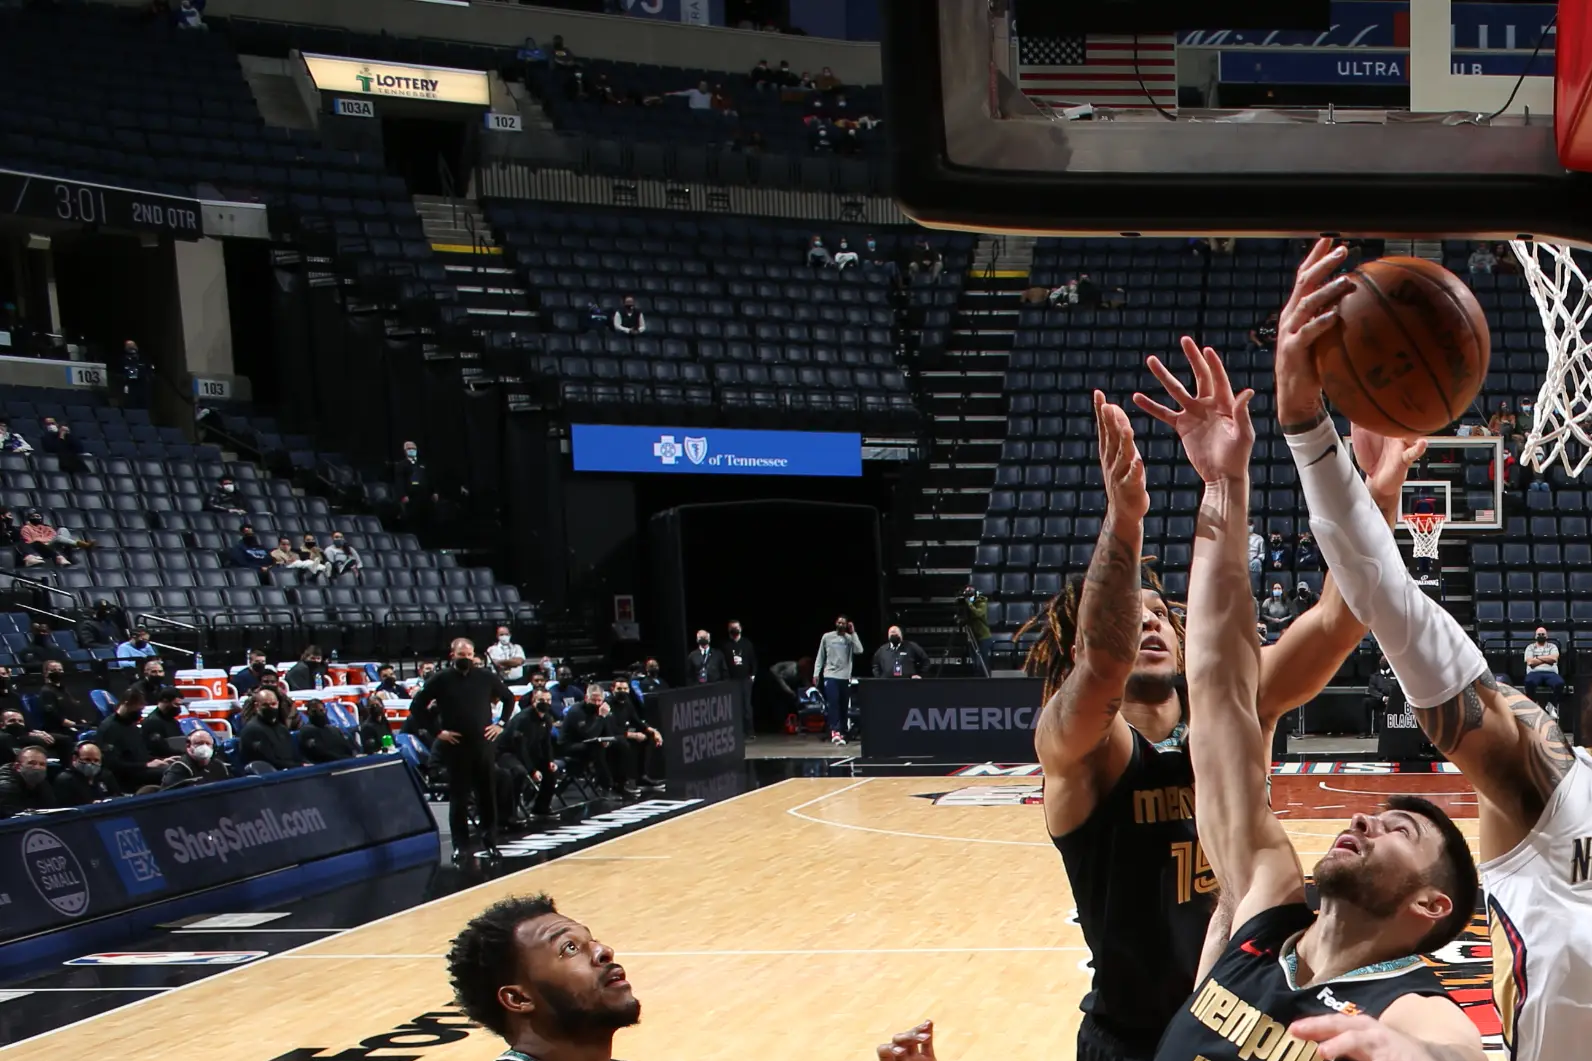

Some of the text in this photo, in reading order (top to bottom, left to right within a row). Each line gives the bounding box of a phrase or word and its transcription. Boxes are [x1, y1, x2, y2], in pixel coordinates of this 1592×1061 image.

[1337, 61, 1401, 76] ULTRA
[376, 74, 439, 92] LOTTERY
[378, 87, 437, 99] TENNESSEE
[341, 101, 371, 116] 103A
[495, 116, 516, 129] 102
[54, 184, 197, 230] 3:01 2ND QTR
[77, 369, 100, 383] 103
[203, 382, 224, 396] 103
[708, 454, 788, 467] of Tennessee
[213, 681, 222, 696] G
[671, 694, 733, 733] AMERICAN
[902, 706, 1043, 731] AMERIC
[1387, 714, 1418, 729] BLACK
[681, 726, 736, 764] EXPRESS
[164, 806, 328, 864] ShopSmall.com
[36, 855, 68, 875] SHOP
[1171, 841, 1222, 904] 15
[41, 870, 81, 890] SMALL
